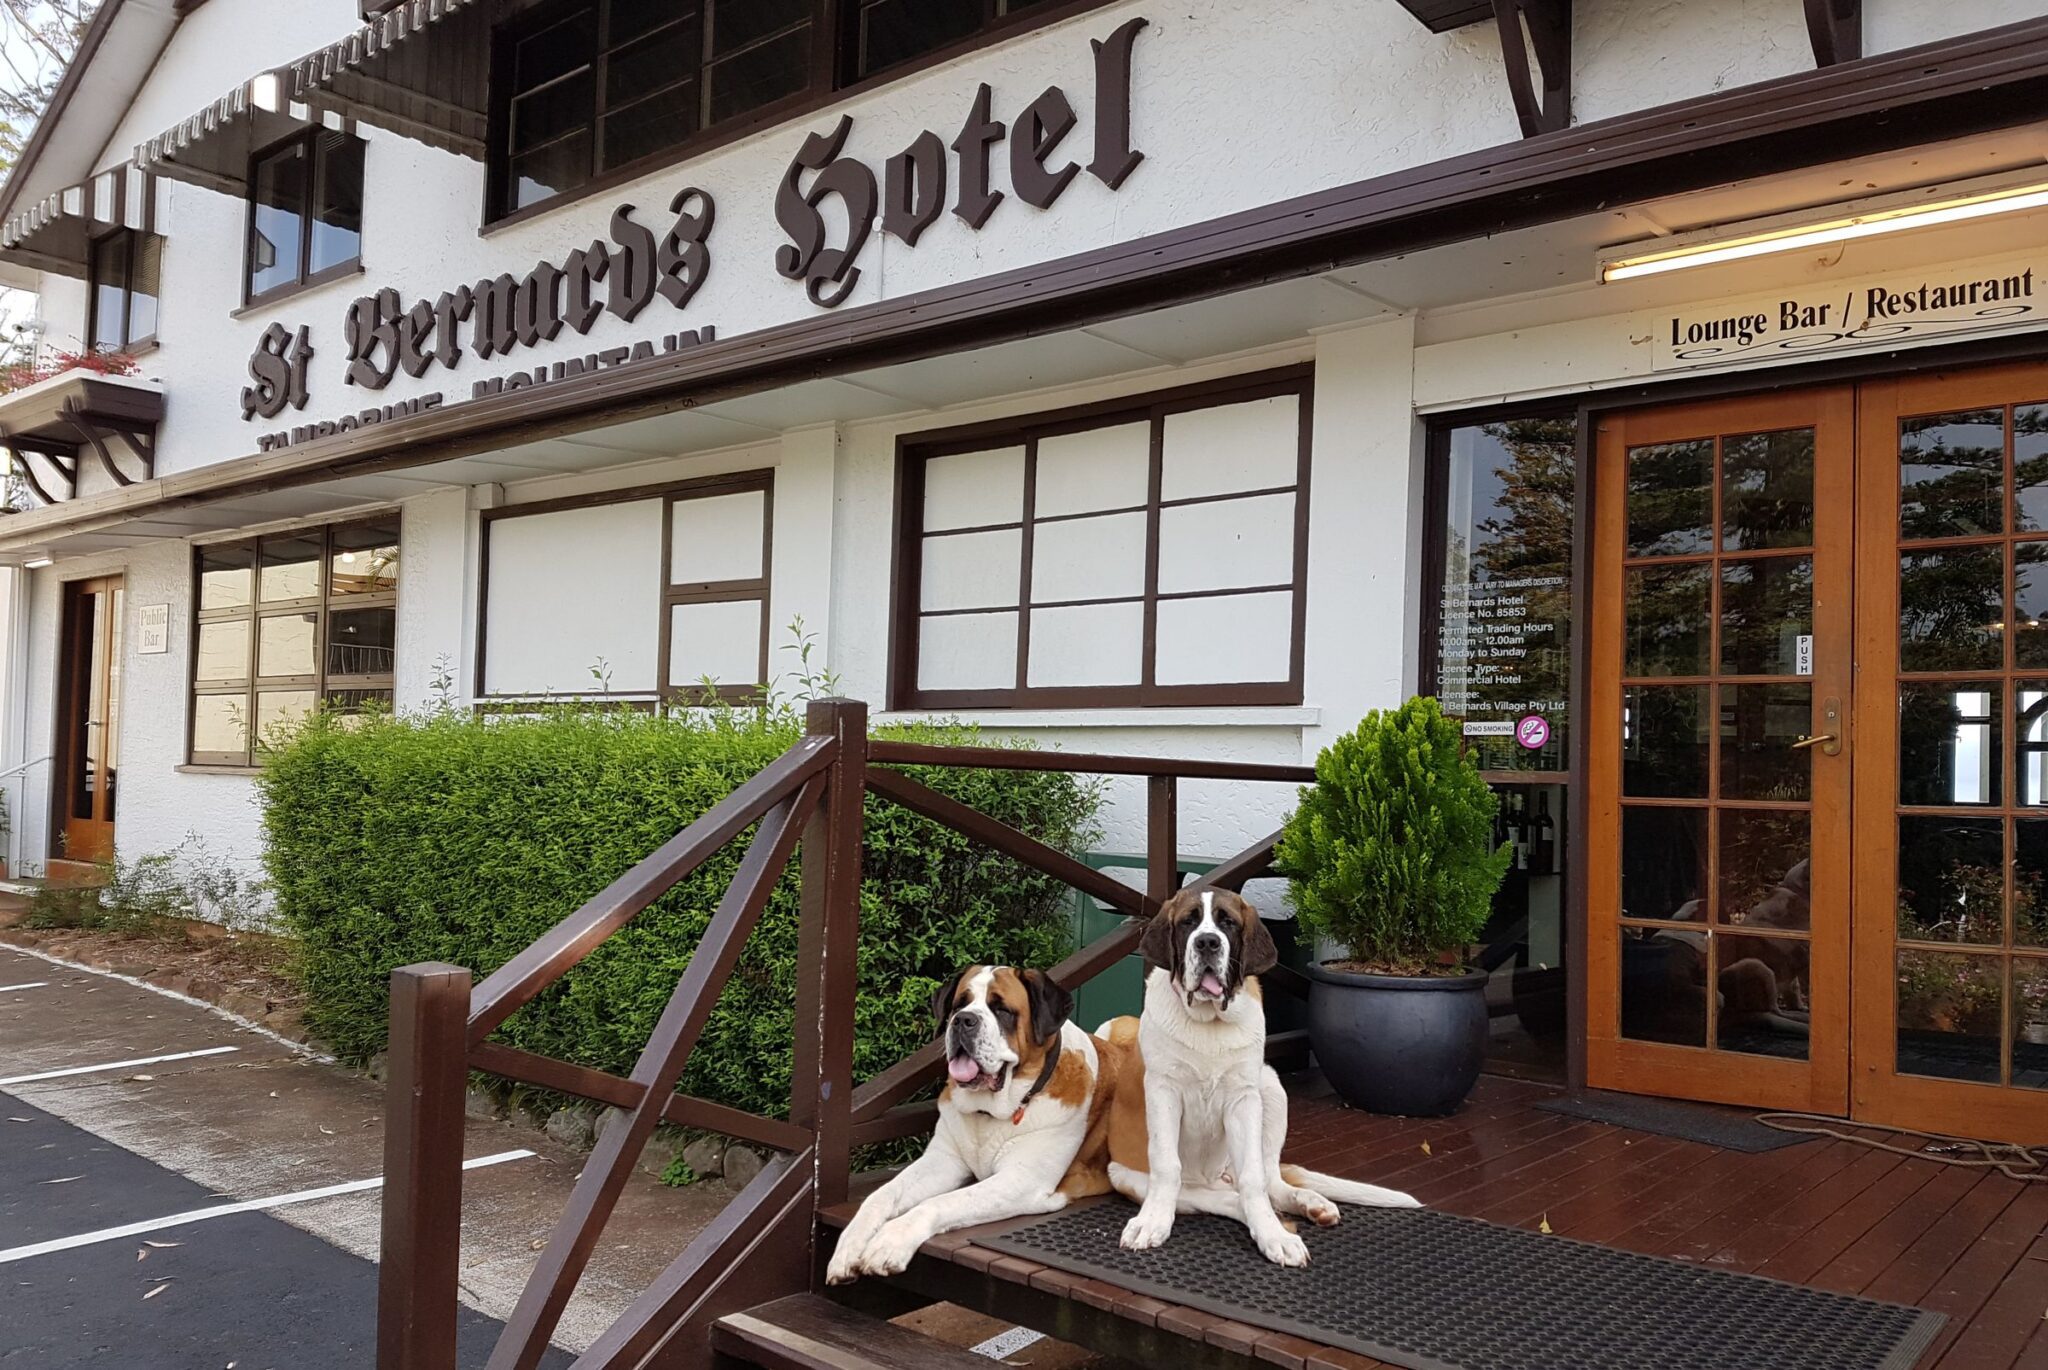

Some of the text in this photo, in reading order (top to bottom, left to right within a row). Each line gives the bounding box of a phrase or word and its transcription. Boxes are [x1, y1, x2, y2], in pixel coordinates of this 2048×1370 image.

[241, 322, 314, 421] St
[775, 17, 1149, 308] Hotel
[1671, 310, 1768, 346] Lounge
[1779, 300, 1831, 331] Bar
[1866, 267, 2034, 318] Restaurant
[1452, 598, 1495, 607] Bernards
[1498, 595, 1524, 605] Hotel
[140, 608, 166, 626] Public
[1440, 607, 1526, 620] Licence No. 85853
[1439, 622, 1554, 635] Permitted Trading Hours
[144, 630, 160, 647] Bar
[1439, 638, 1476, 646] 10.00am
[1486, 636, 1524, 645] 12.00am
[1438, 648, 1527, 659] Monday to Sunday
[1437, 663, 1500, 675] Licence Type:
[1437, 675, 1521, 685] Commercial Hotel
[1436, 690, 1480, 699] Licensee:
[1448, 702, 1491, 711] Bernards
[1493, 701, 1527, 712] Village
[1529, 701, 1546, 712] Pty
[1548, 701, 1565, 710] Ltd
